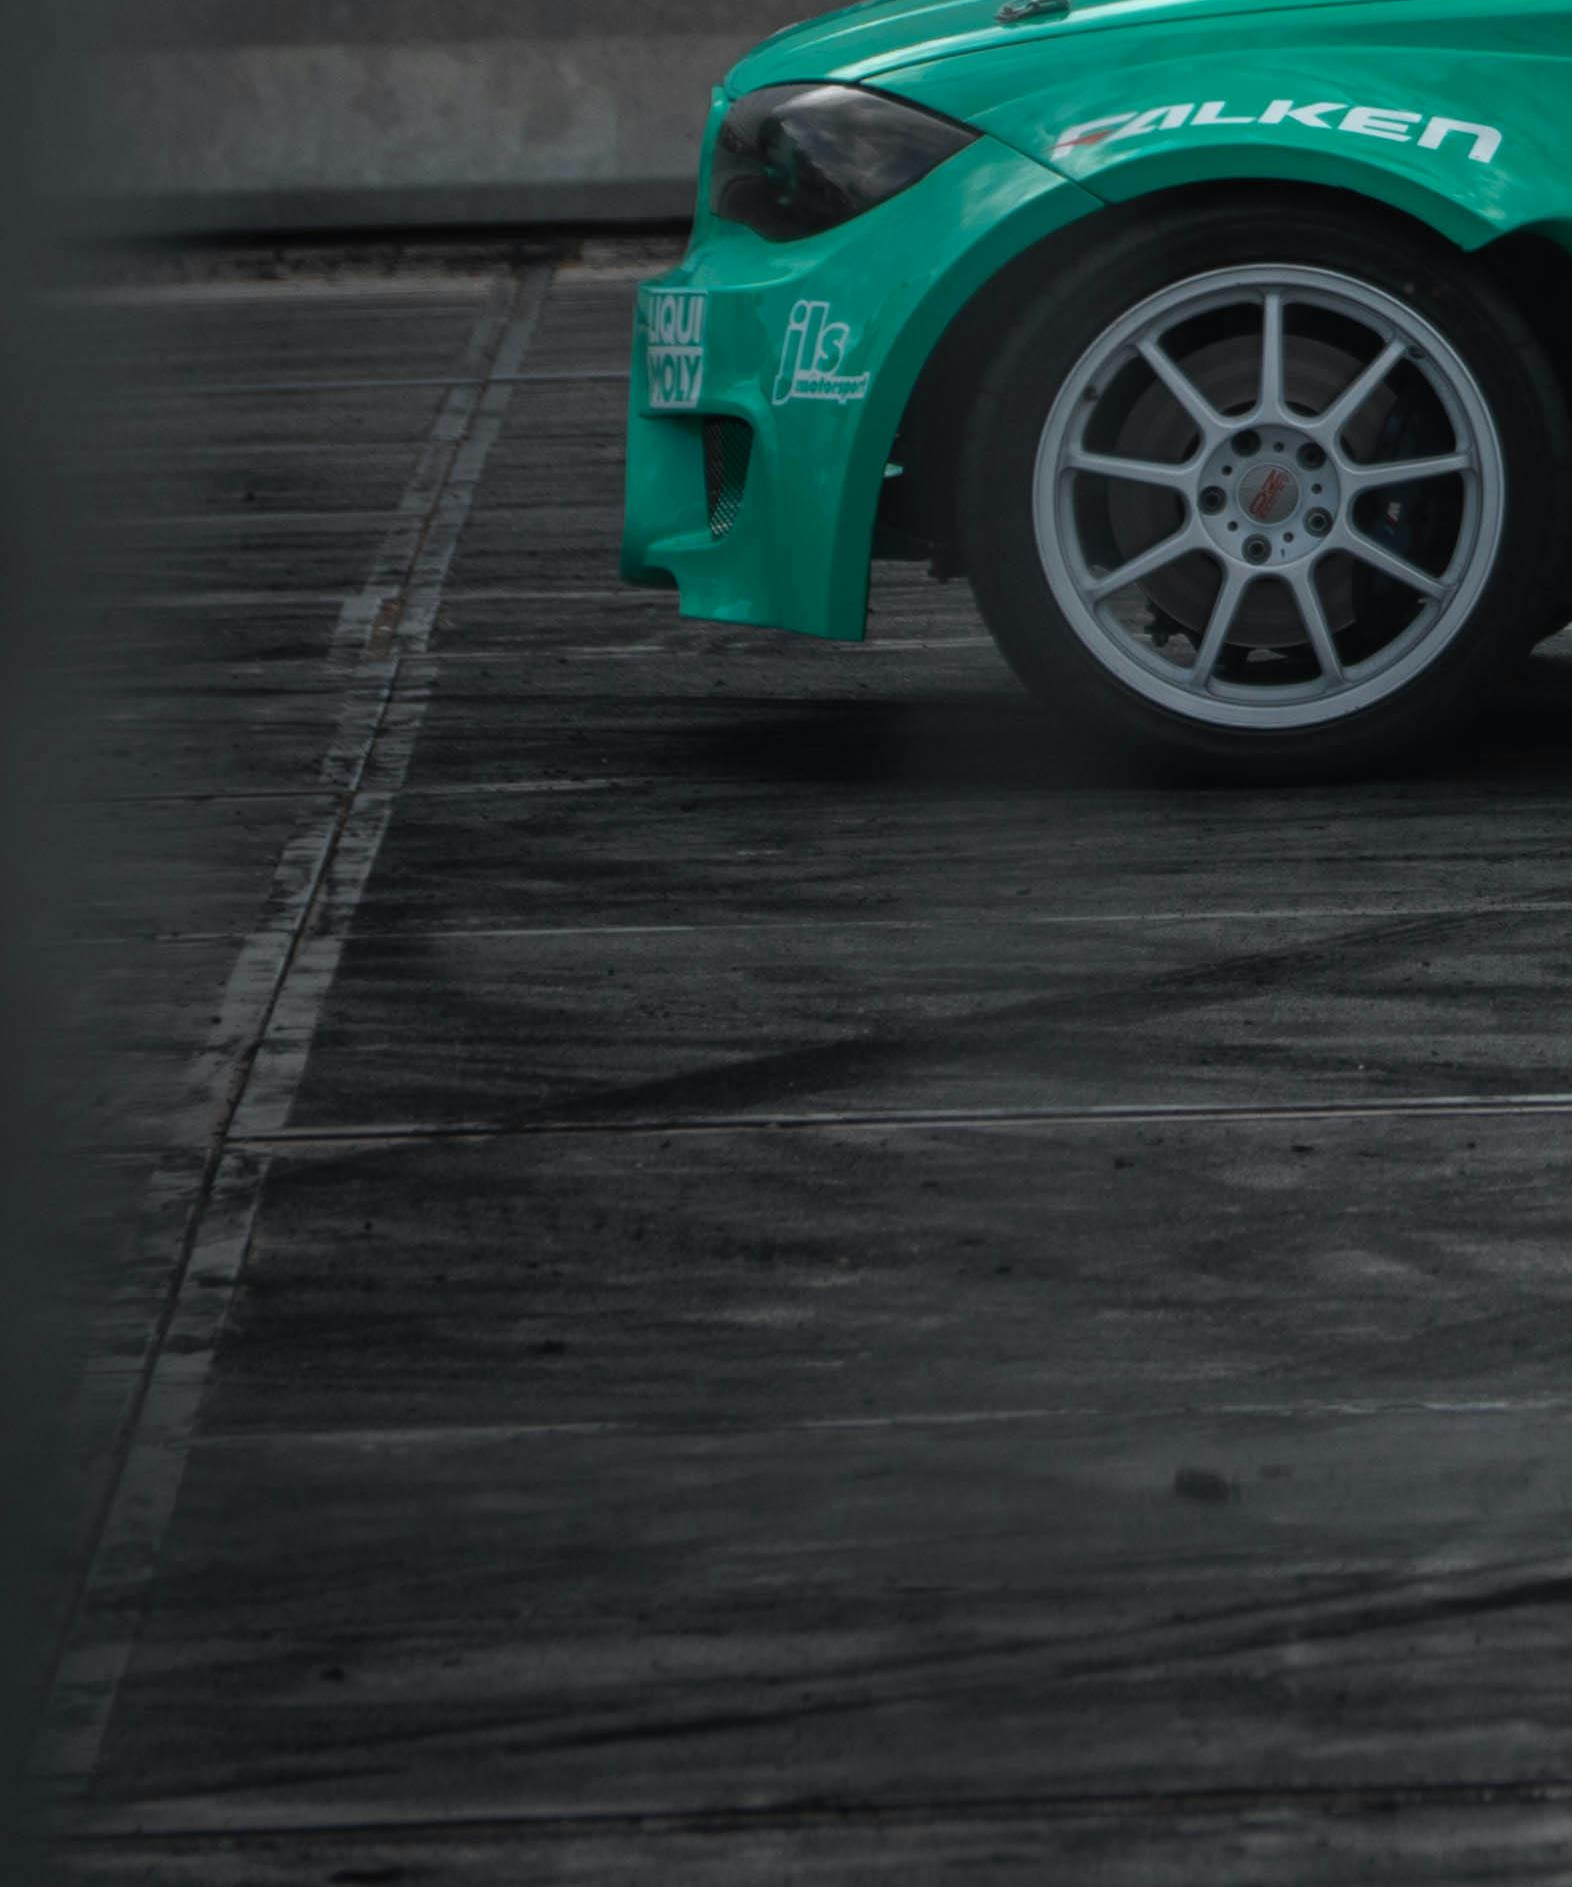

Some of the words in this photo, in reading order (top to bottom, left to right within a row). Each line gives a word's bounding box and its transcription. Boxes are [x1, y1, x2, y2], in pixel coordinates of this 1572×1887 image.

[1052, 99, 1502, 164] FALKEN
[648, 294, 705, 345] LIQUI
[648, 354, 703, 402] MOLY
